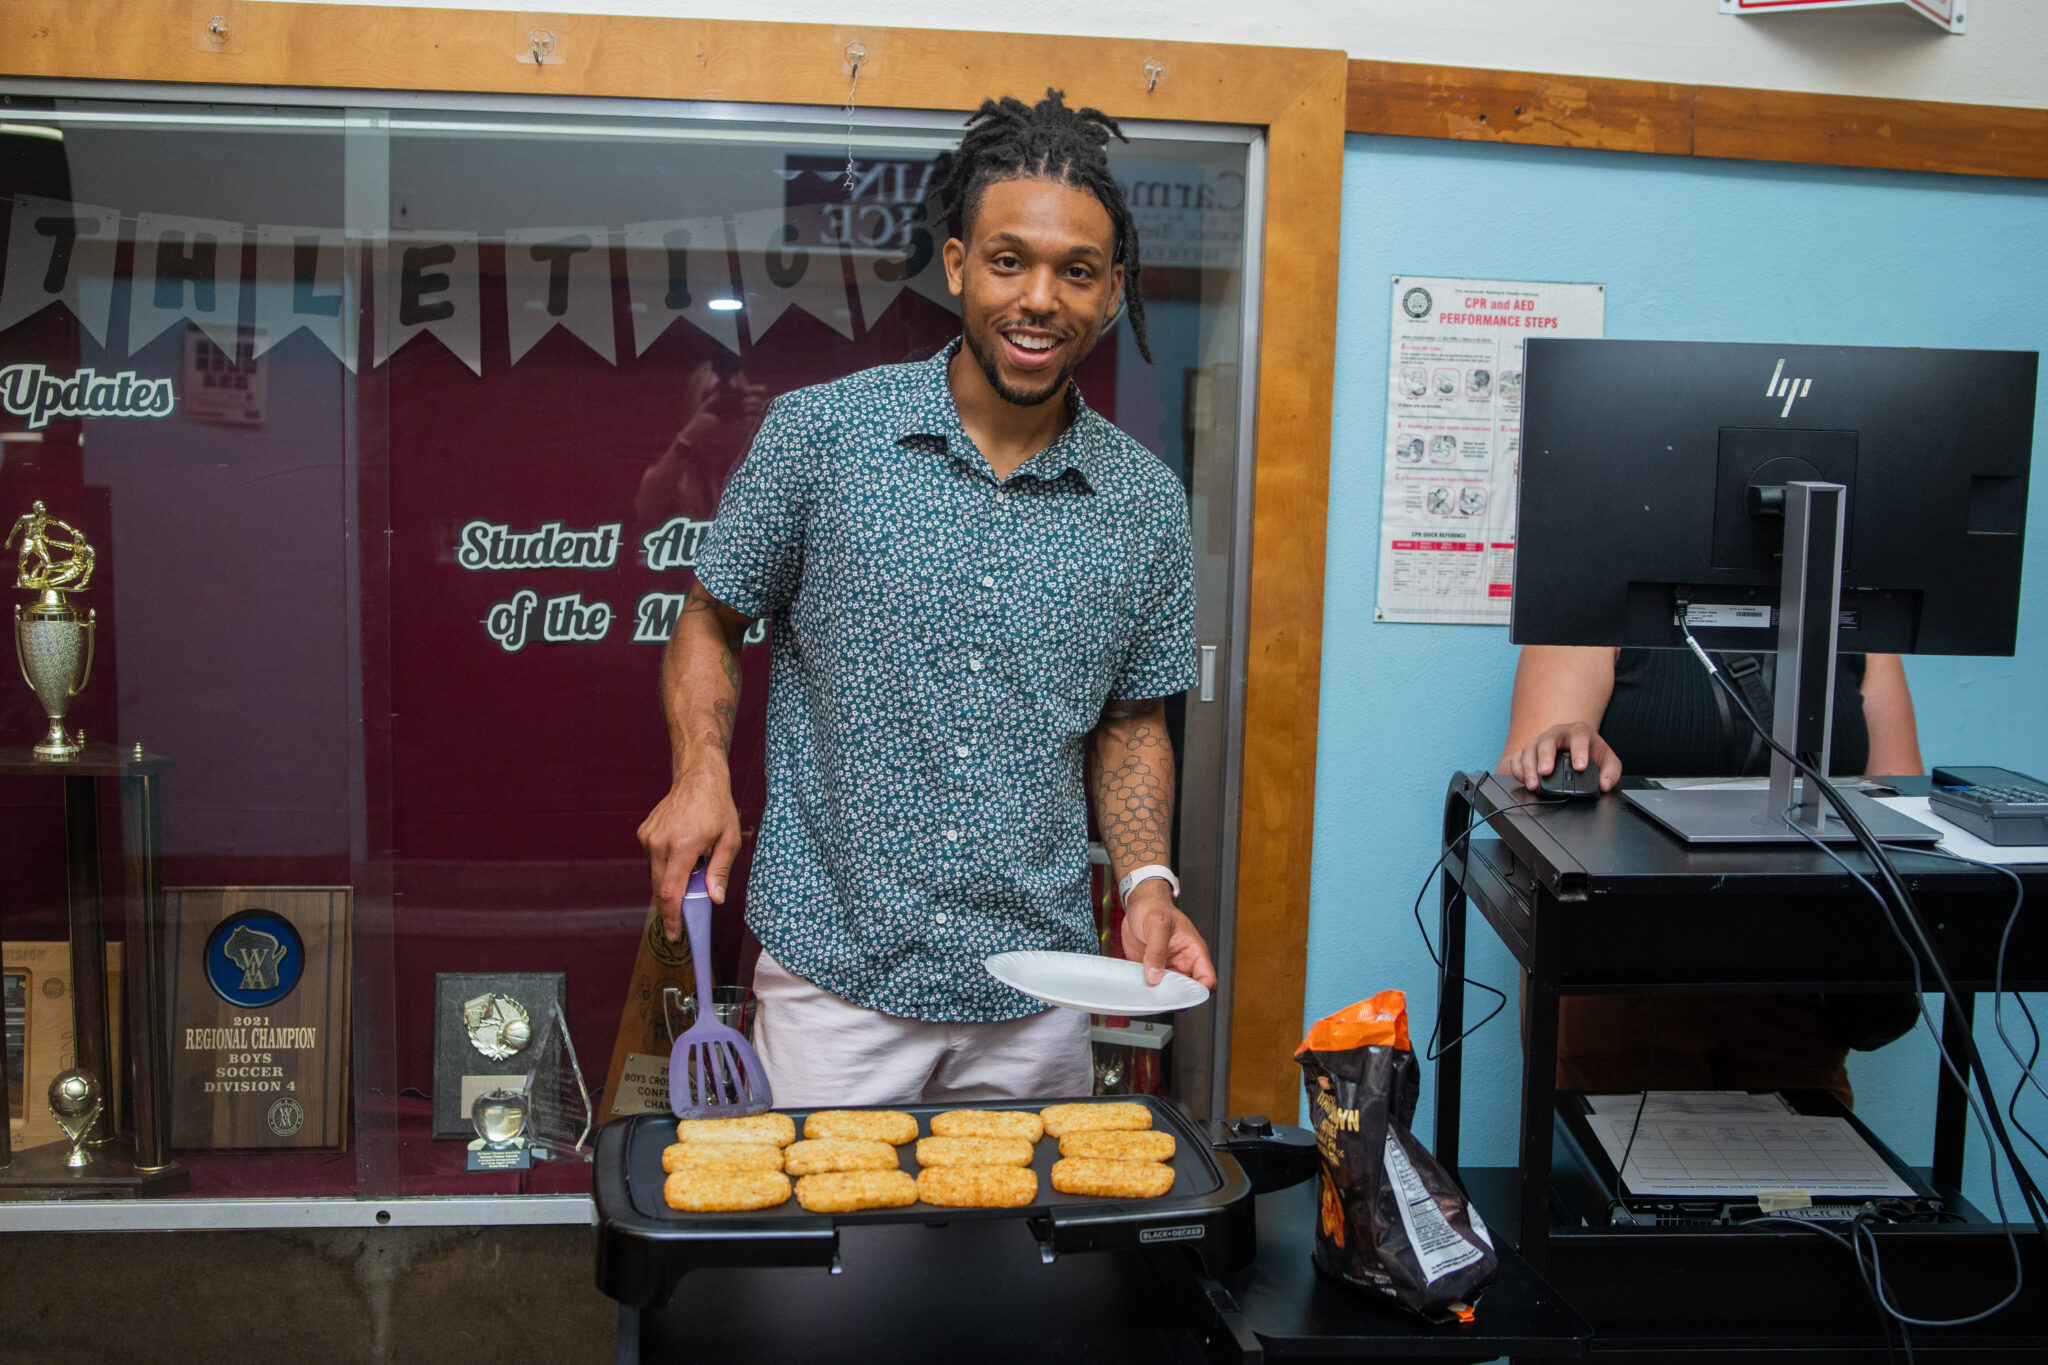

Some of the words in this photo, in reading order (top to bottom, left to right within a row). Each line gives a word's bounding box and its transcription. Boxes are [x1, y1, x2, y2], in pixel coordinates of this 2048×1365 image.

[1464, 297, 1487, 310] CPR
[1490, 299, 1510, 311] and
[1513, 300, 1535, 312] AED
[1439, 313, 1521, 328] PERFORMANCE
[1524, 316, 1558, 329] STEPS
[1766, 358, 1812, 418] hp
[1, 365, 173, 428] Updates
[460, 522, 621, 568] Student
[647, 518, 708, 569] At
[490, 592, 536, 649] of
[546, 595, 610, 640] the
[233, 1016, 270, 1026] 2021
[185, 1028, 248, 1050] REGIONAL
[251, 1027, 316, 1049] CHAMPION
[229, 1053, 272, 1064] BOYS
[216, 1067, 284, 1078] SOCCER
[624, 1072, 647, 1083] BOYS
[204, 1081, 281, 1092] DIVISION
[286, 1081, 296, 1092] 4
[637, 1086, 669, 1098] CONFE
[644, 1099, 671, 1111] CHAM
